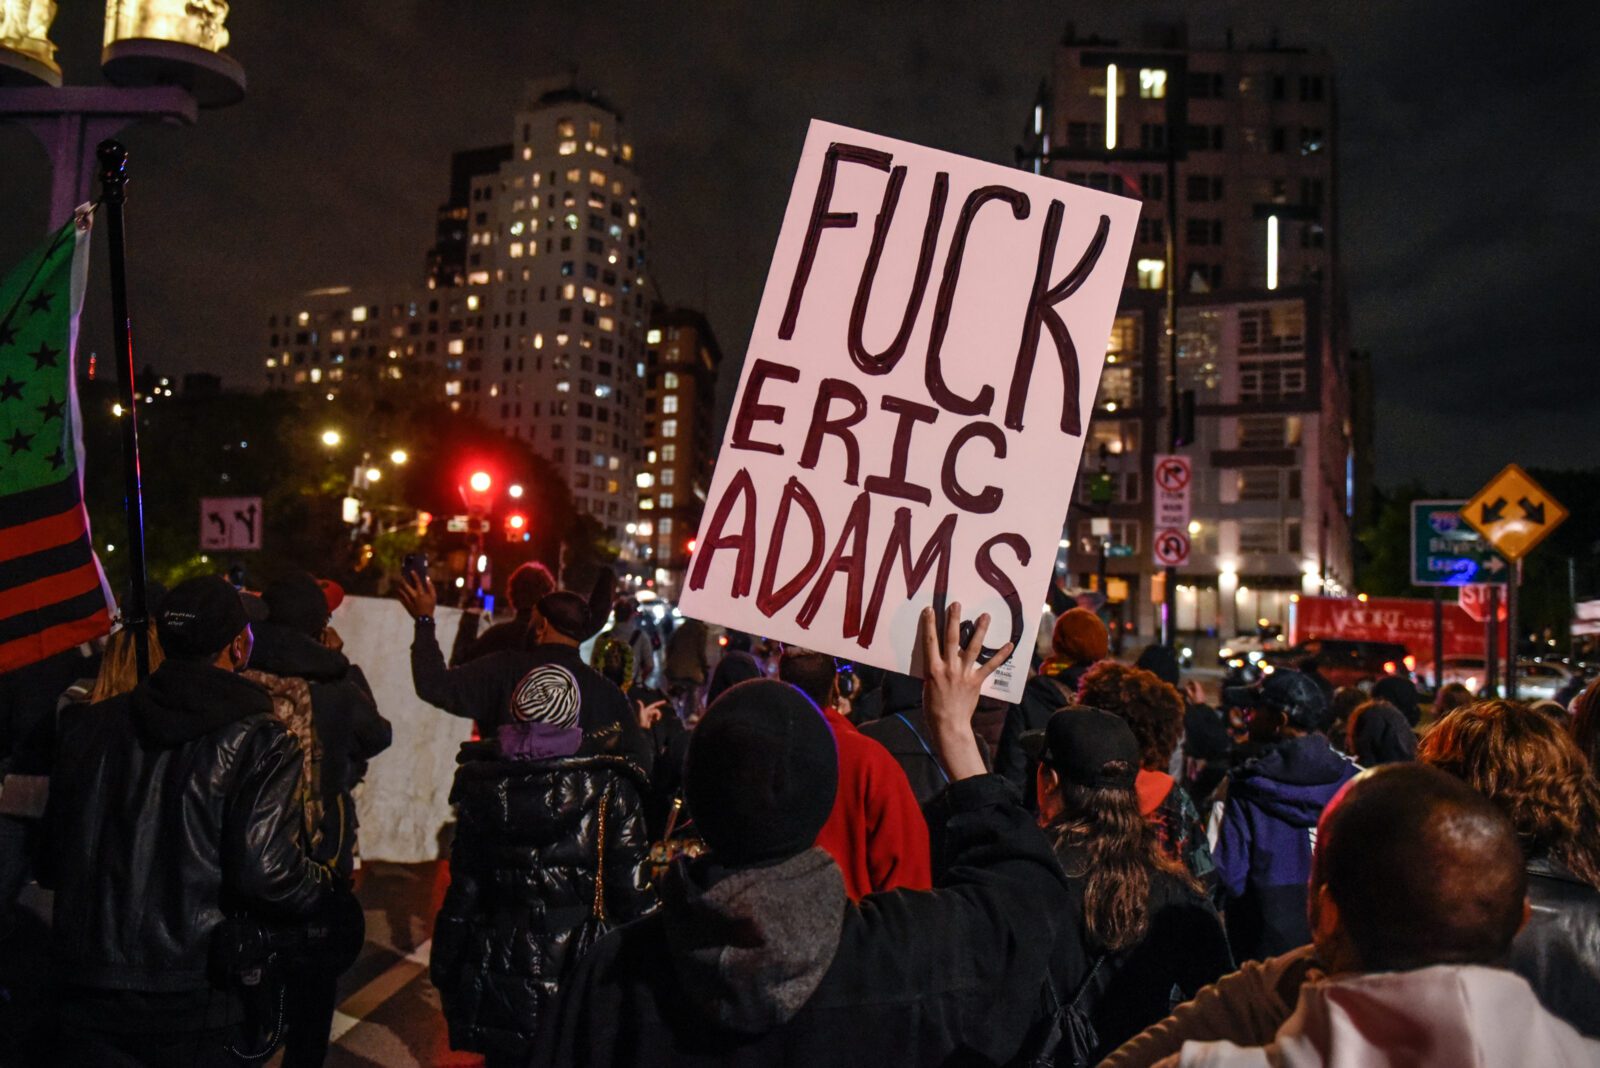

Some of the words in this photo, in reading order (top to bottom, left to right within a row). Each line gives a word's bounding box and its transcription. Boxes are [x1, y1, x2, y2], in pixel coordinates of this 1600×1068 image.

[778, 142, 1111, 436] FUCK
[730, 357, 1008, 514] ERIC
[689, 467, 1032, 665] ADAMS
